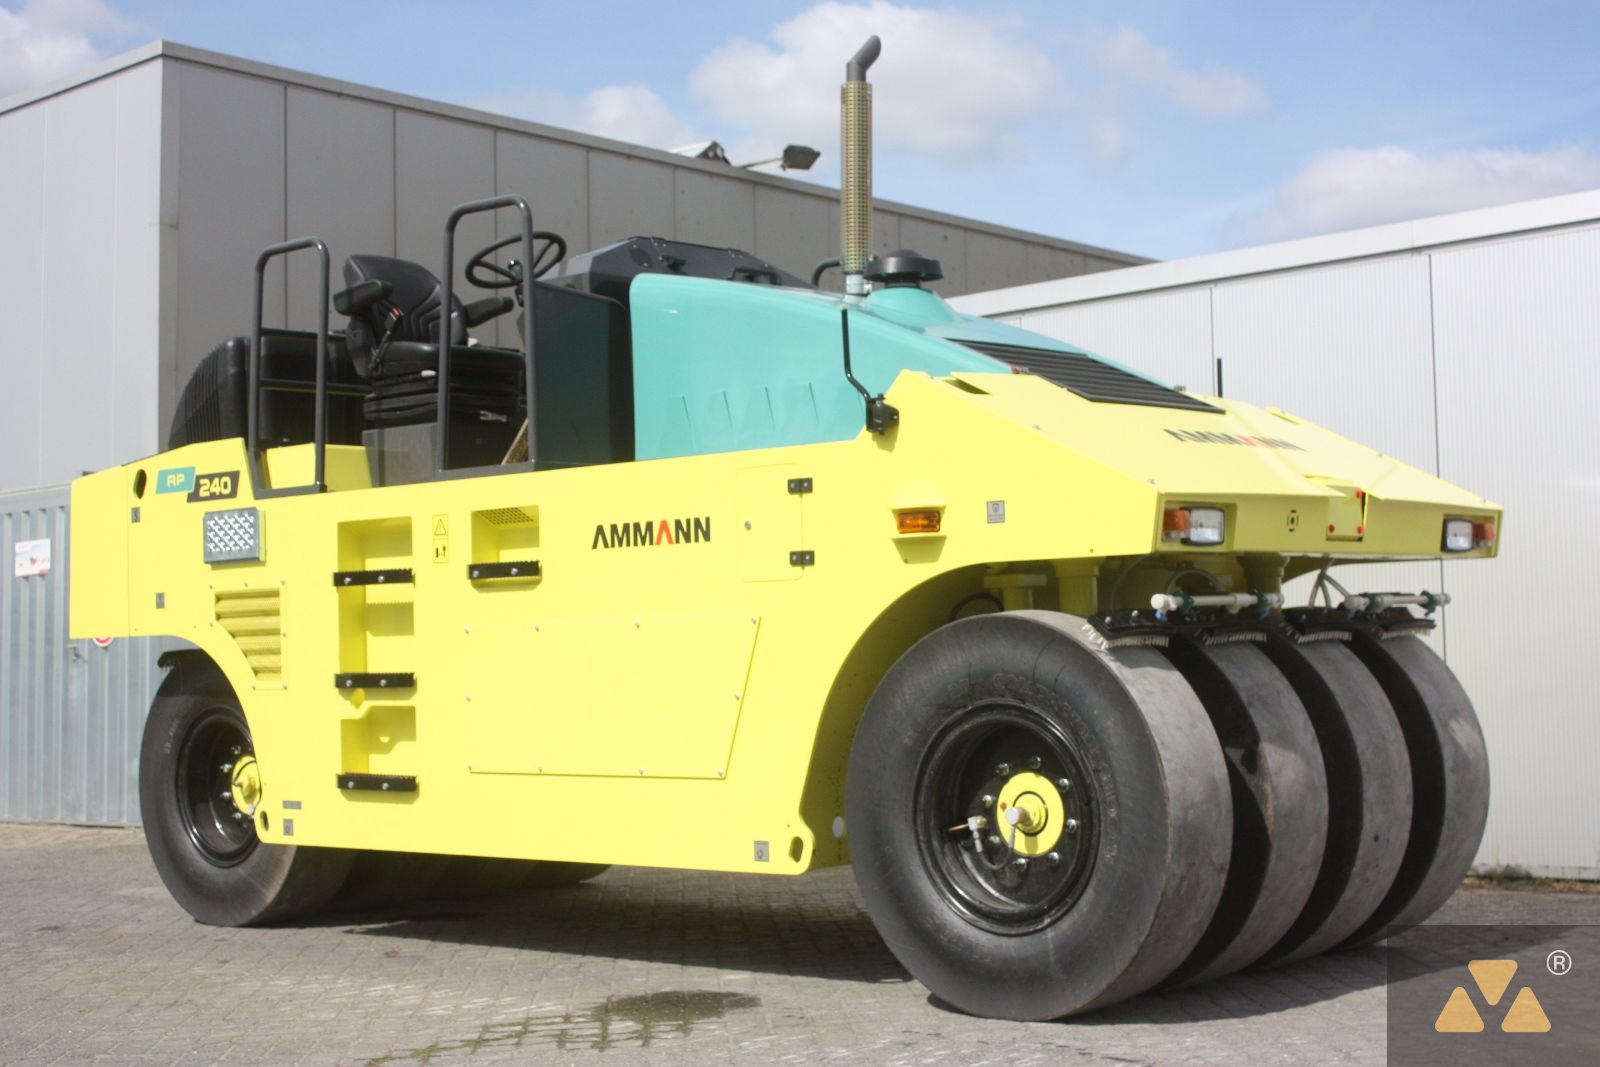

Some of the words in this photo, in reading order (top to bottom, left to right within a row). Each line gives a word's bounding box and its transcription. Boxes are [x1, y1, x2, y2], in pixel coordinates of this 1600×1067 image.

[167, 473, 185, 488] AP
[199, 476, 232, 498] 240
[591, 516, 711, 550] AMMANN
